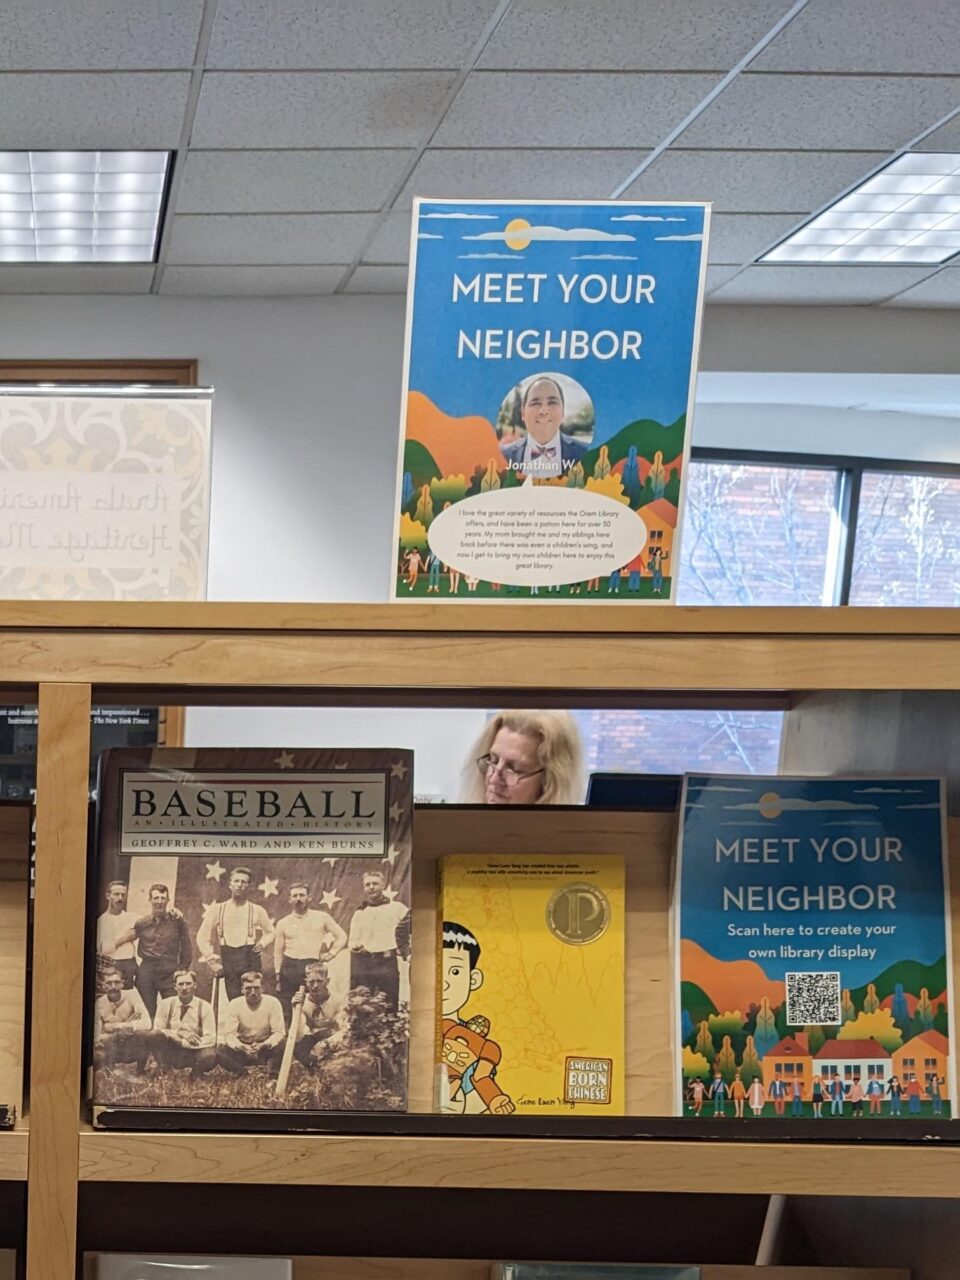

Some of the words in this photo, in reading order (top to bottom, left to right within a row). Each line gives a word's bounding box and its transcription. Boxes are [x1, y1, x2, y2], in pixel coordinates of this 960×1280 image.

[452, 274, 547, 303] MEET
[558, 274, 656, 304] YOUR
[458, 329, 642, 360] NEIGHBOR
[506, 459, 559, 471] Jonathan
[561, 459, 577, 471] W.
[489, 510, 505, 518] great
[507, 510, 527, 519] variety
[132, 789, 375, 818] BASEBALL
[716, 838, 799, 863] MEET
[810, 837, 902, 863] YOUR
[724, 885, 896, 911] NEIGHBOR
[728, 924, 759, 936] Scan
[763, 924, 794, 936] here
[799, 924, 813, 936] to
[817, 924, 862, 935] create
[866, 924, 896, 937] your
[748, 948, 776, 959] own
[780, 946, 824, 960] library
[828, 945, 876, 960] display
[568, 1060, 609, 1072] AMERICAN
[568, 1072, 608, 1087] BORN
[567, 1086, 607, 1100] CHINESE
